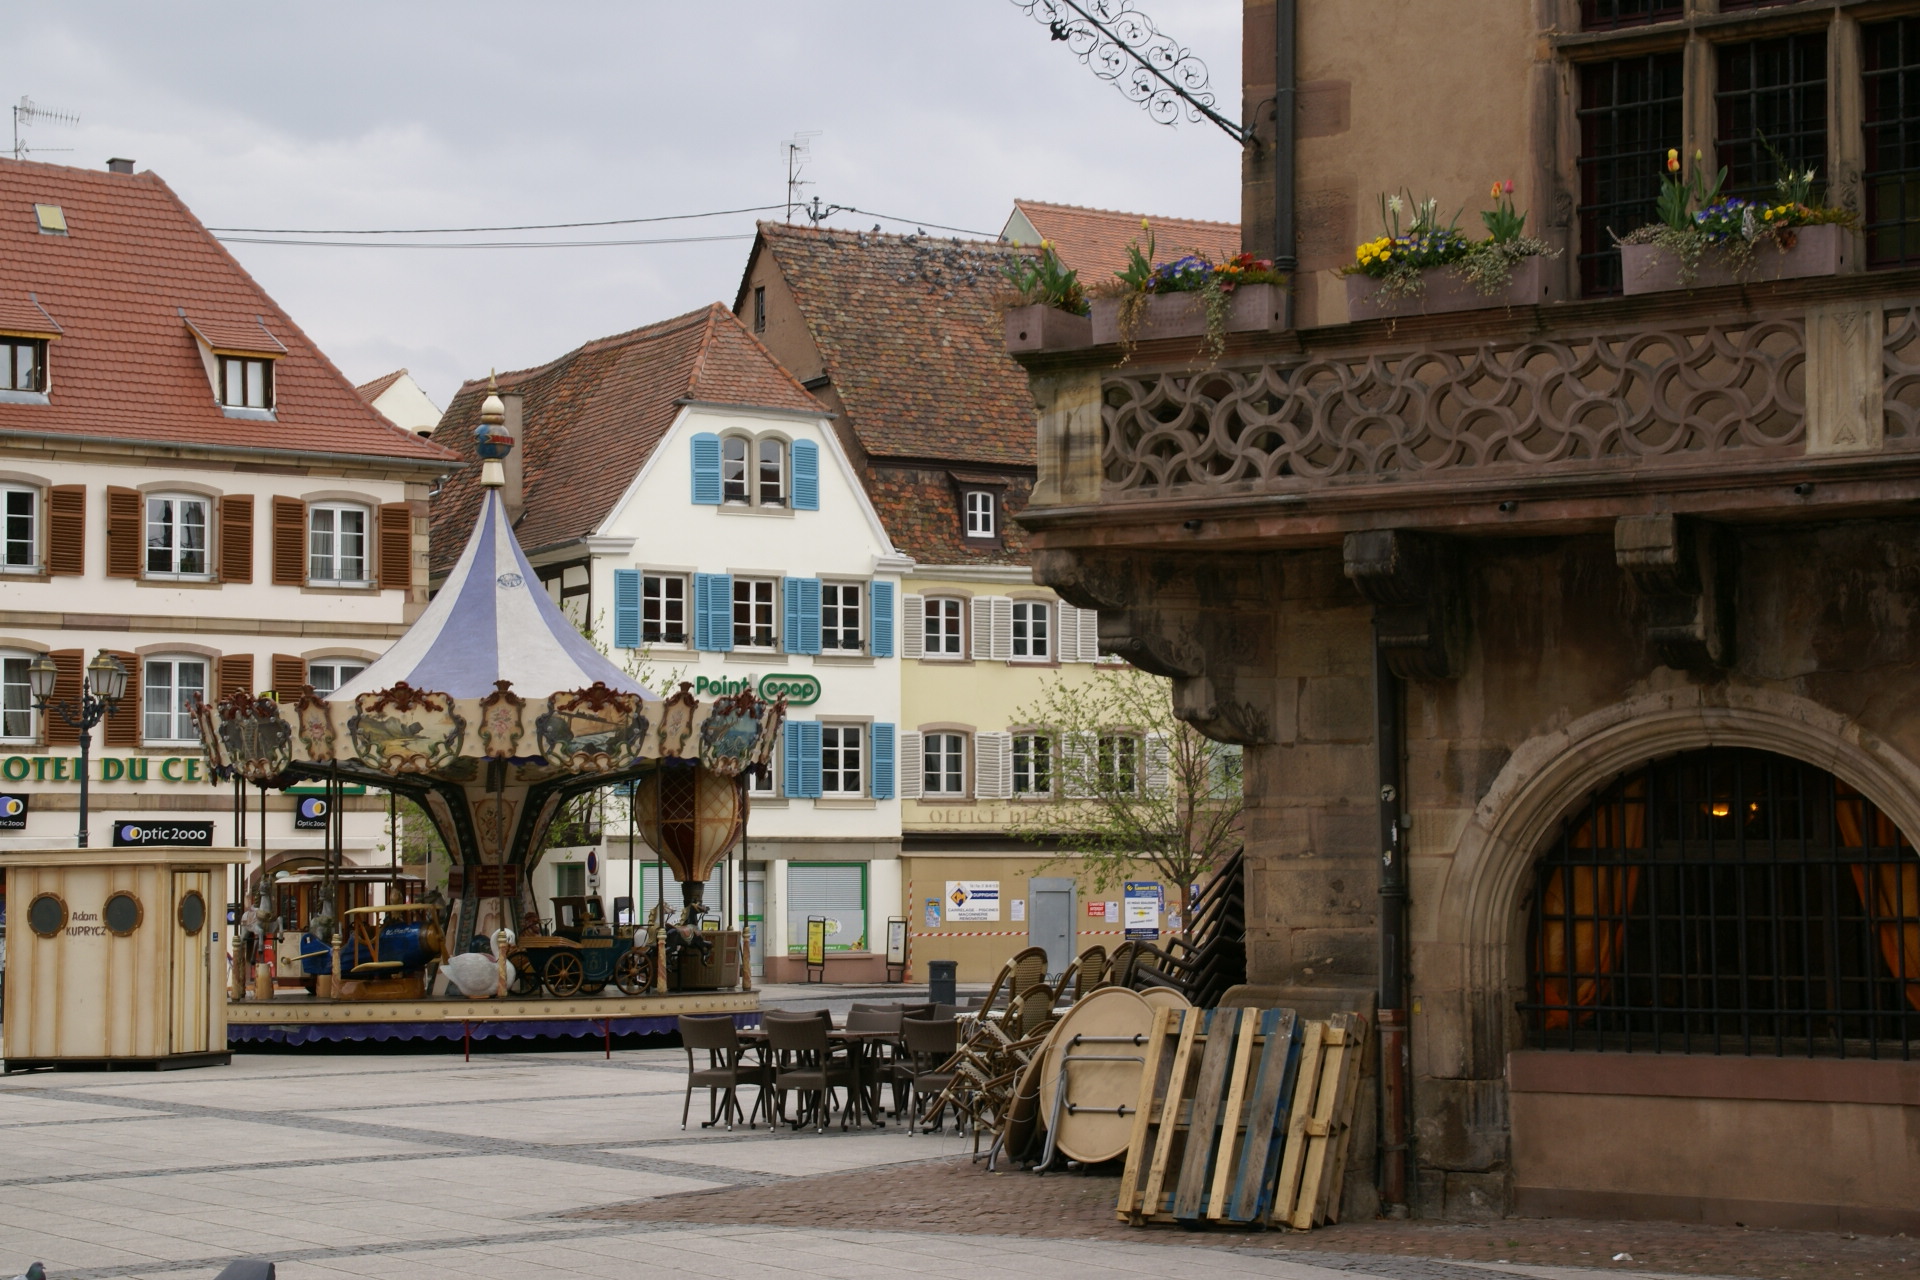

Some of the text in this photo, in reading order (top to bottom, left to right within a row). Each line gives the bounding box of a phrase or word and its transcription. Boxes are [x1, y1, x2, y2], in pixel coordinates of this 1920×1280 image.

[695, 675, 750, 696] Point
[100, 757, 149, 781] DU
[160, 757, 206, 782] CE
[297, 820, 314, 828] Optic
[130, 827, 207, 843] Optic 2000
[72, 911, 98, 921] Adam
[65, 926, 106, 936] KUPRYCZ
